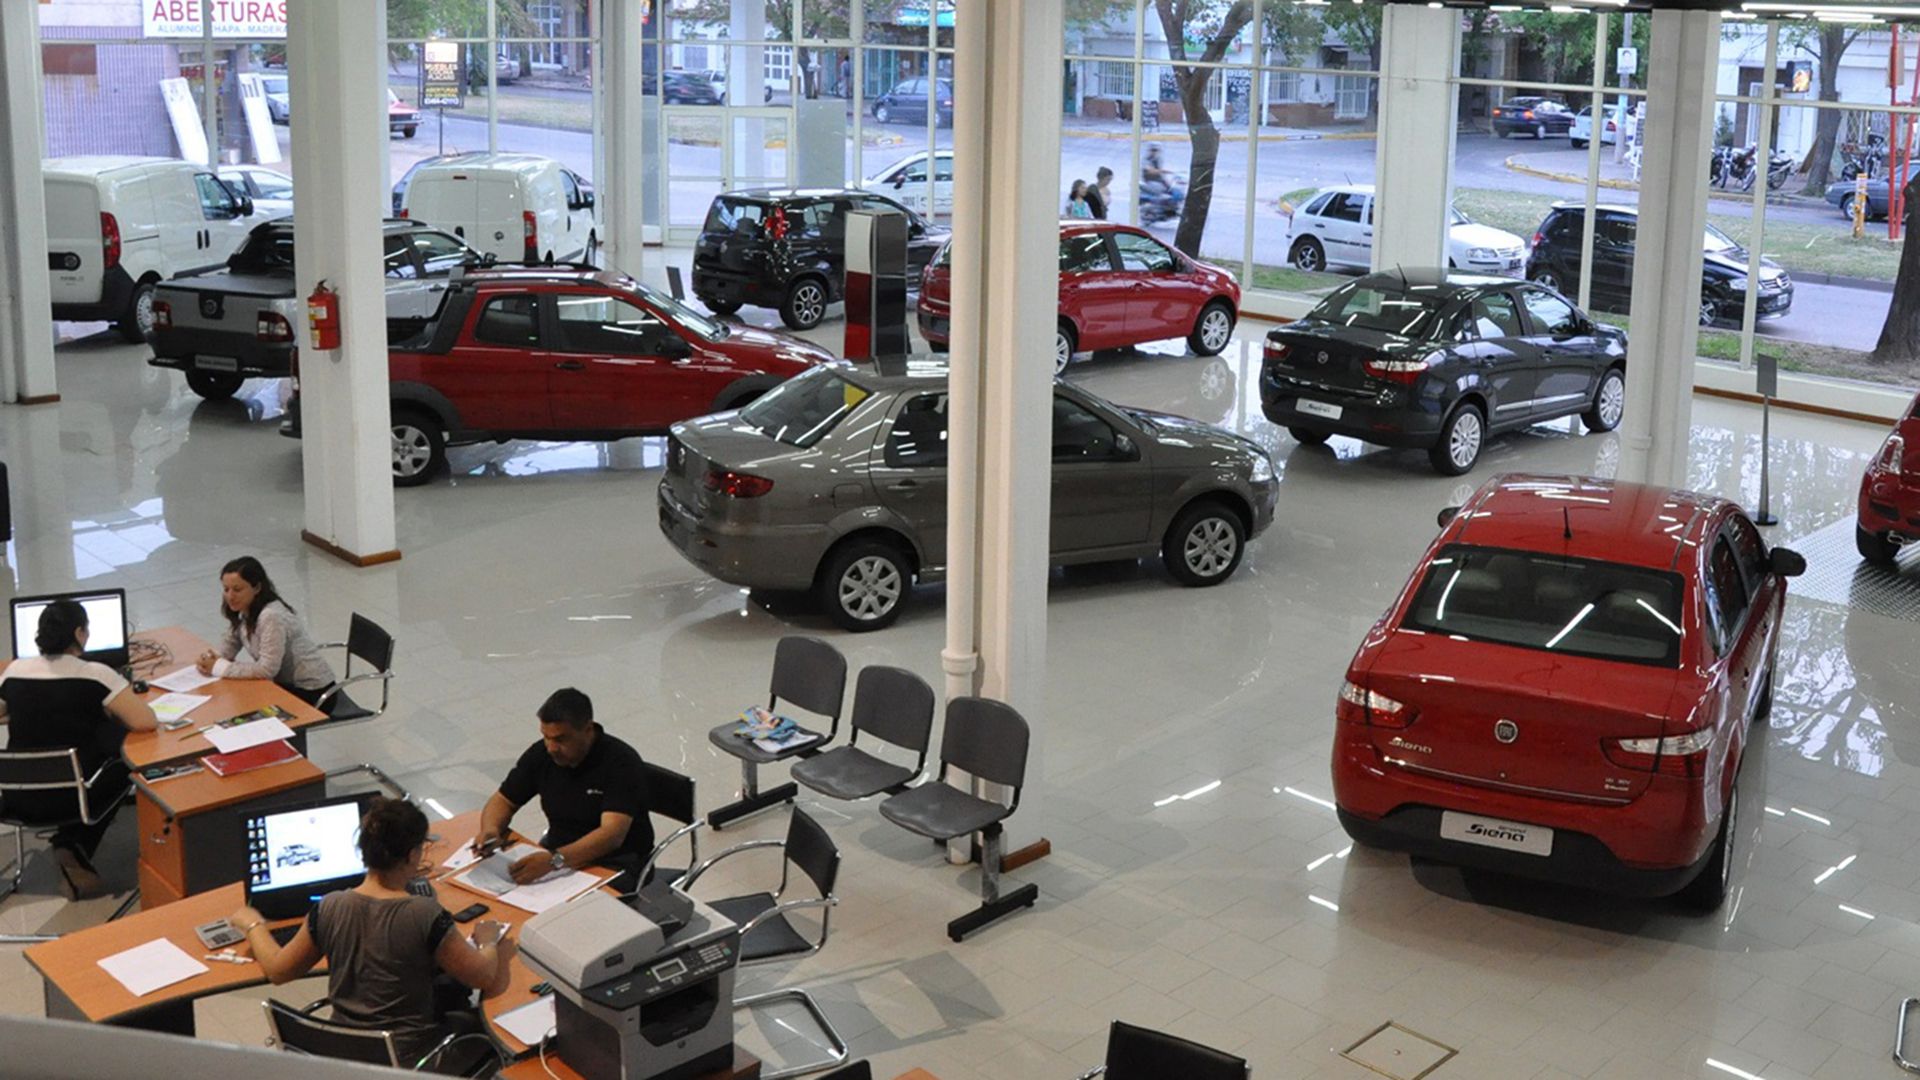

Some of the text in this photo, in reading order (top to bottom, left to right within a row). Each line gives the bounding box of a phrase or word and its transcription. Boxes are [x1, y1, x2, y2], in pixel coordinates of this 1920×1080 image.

[213, 25, 241, 33] HAPA
[1389, 736, 1432, 754] Siena
[1465, 823, 1525, 842] Siena
